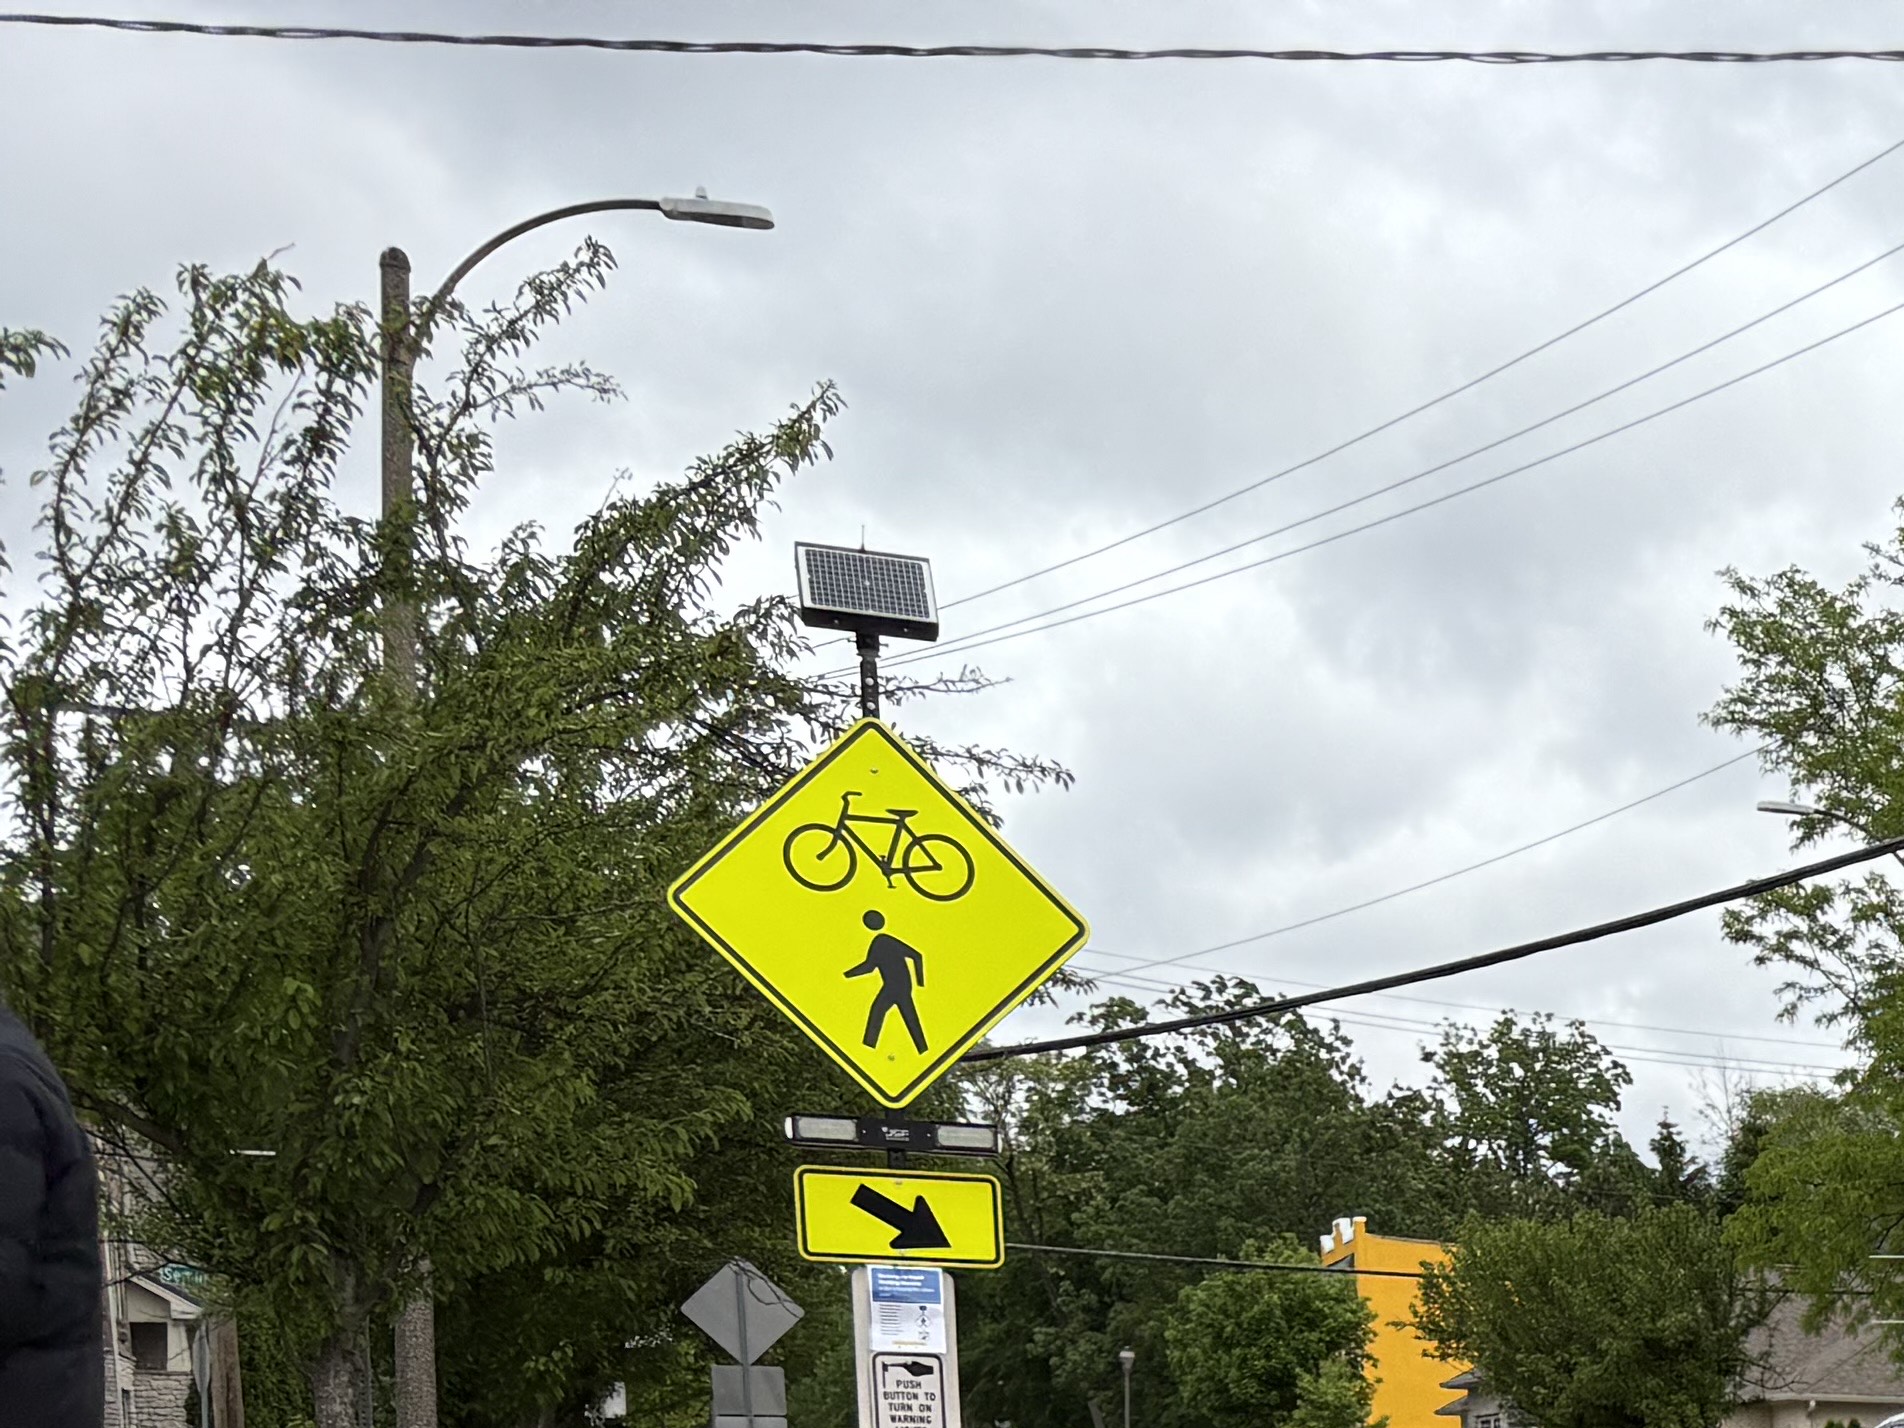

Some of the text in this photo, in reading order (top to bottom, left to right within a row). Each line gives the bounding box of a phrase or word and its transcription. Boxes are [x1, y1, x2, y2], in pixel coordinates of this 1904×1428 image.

[896, 1380, 921, 1389] PUSH
[883, 1391, 936, 1401] BUTTON TO
[888, 1403, 932, 1412] TURN ON
[890, 1415, 932, 1424] WARNING
